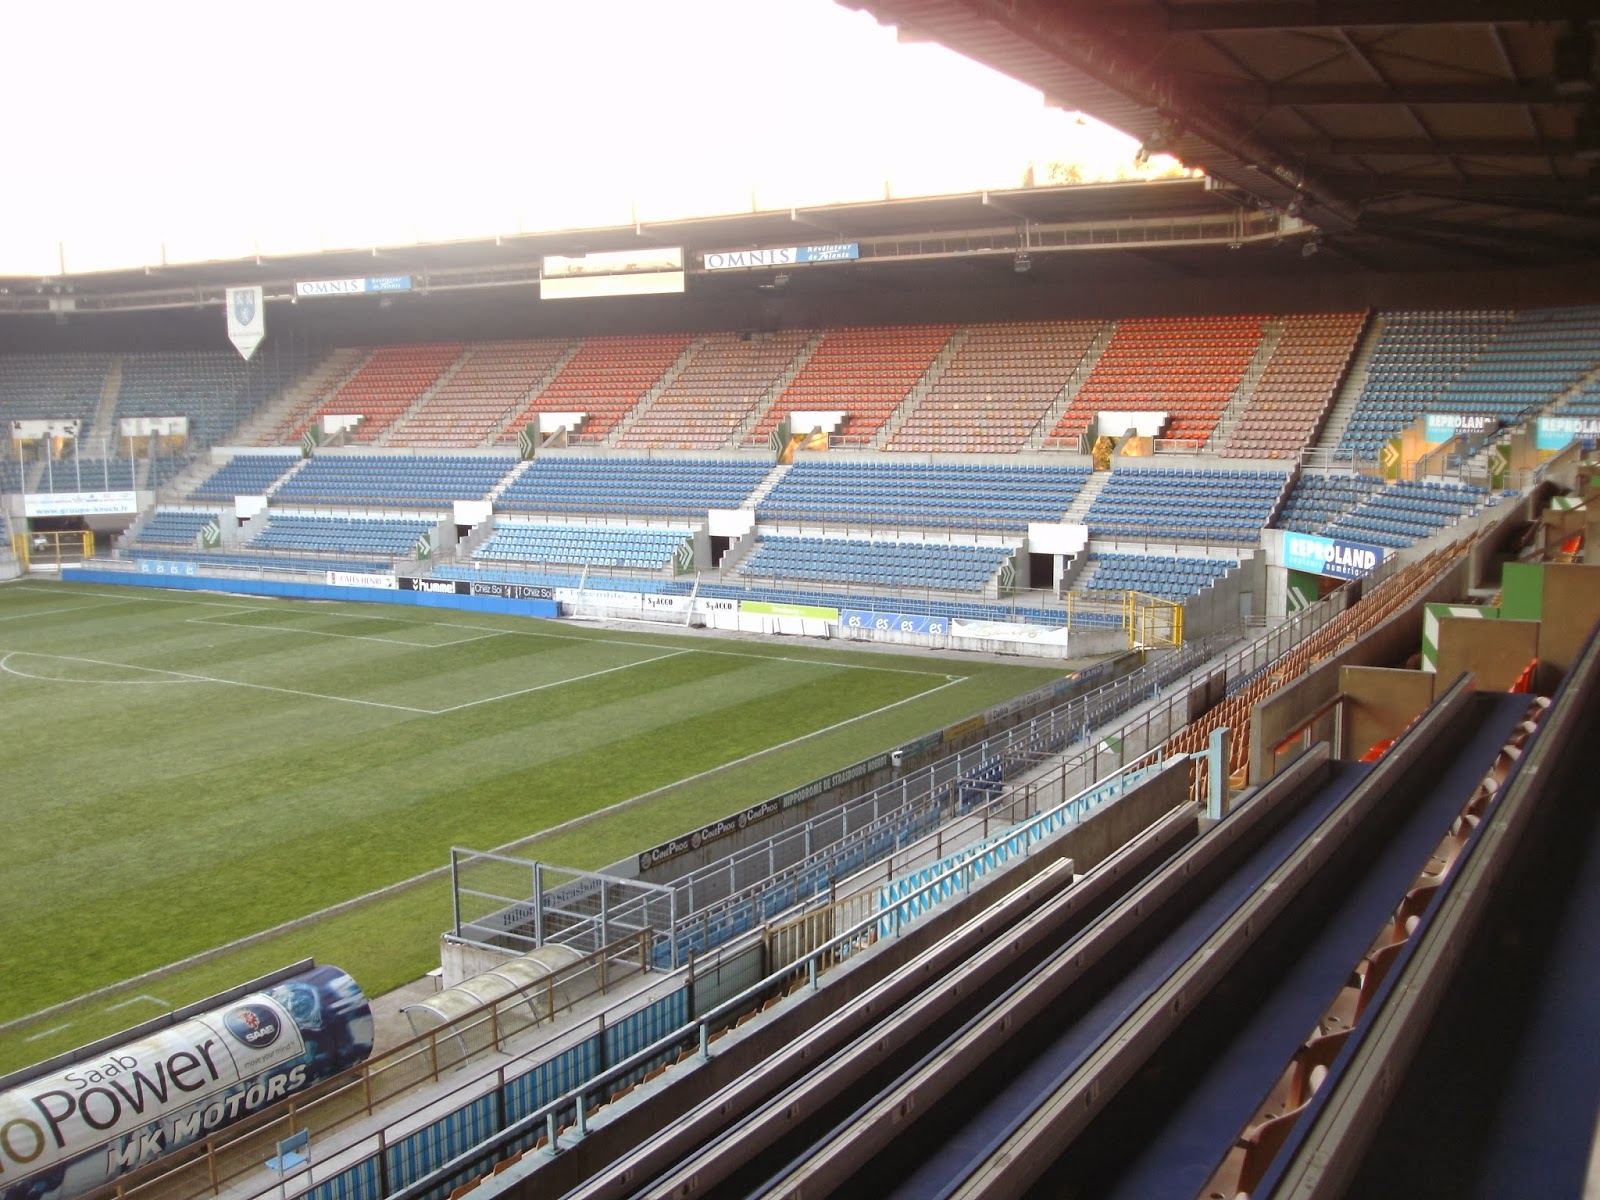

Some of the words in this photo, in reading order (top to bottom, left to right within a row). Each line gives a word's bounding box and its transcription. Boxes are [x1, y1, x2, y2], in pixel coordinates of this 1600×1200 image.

[707, 249, 789, 267] OMNIS
[302, 280, 358, 294] OMNIS
[1541, 418, 1600, 432] REPROLA
[1290, 537, 1376, 569] REPROLAND
[420, 579, 456, 593] hummel
[474, 583, 491, 593] Chez
[523, 587, 540, 597] Chez
[849, 615, 861, 627] es
[875, 618, 889, 630] es
[900, 619, 914, 632] es
[929, 622, 942, 634] es
[783, 781, 823, 808] HIPPODROME
[823, 779, 832, 791] DE
[832, 764, 867, 786] STRASBOURG
[245, 1024, 275, 1042] SAAB
[244, 1057, 262, 1069] move
[262, 1051, 275, 1063] your
[65, 1053, 138, 1090] Saab
[0, 1038, 220, 1174] oPower
[106, 1127, 166, 1175] MK
[171, 1064, 307, 1144] MOTORS
